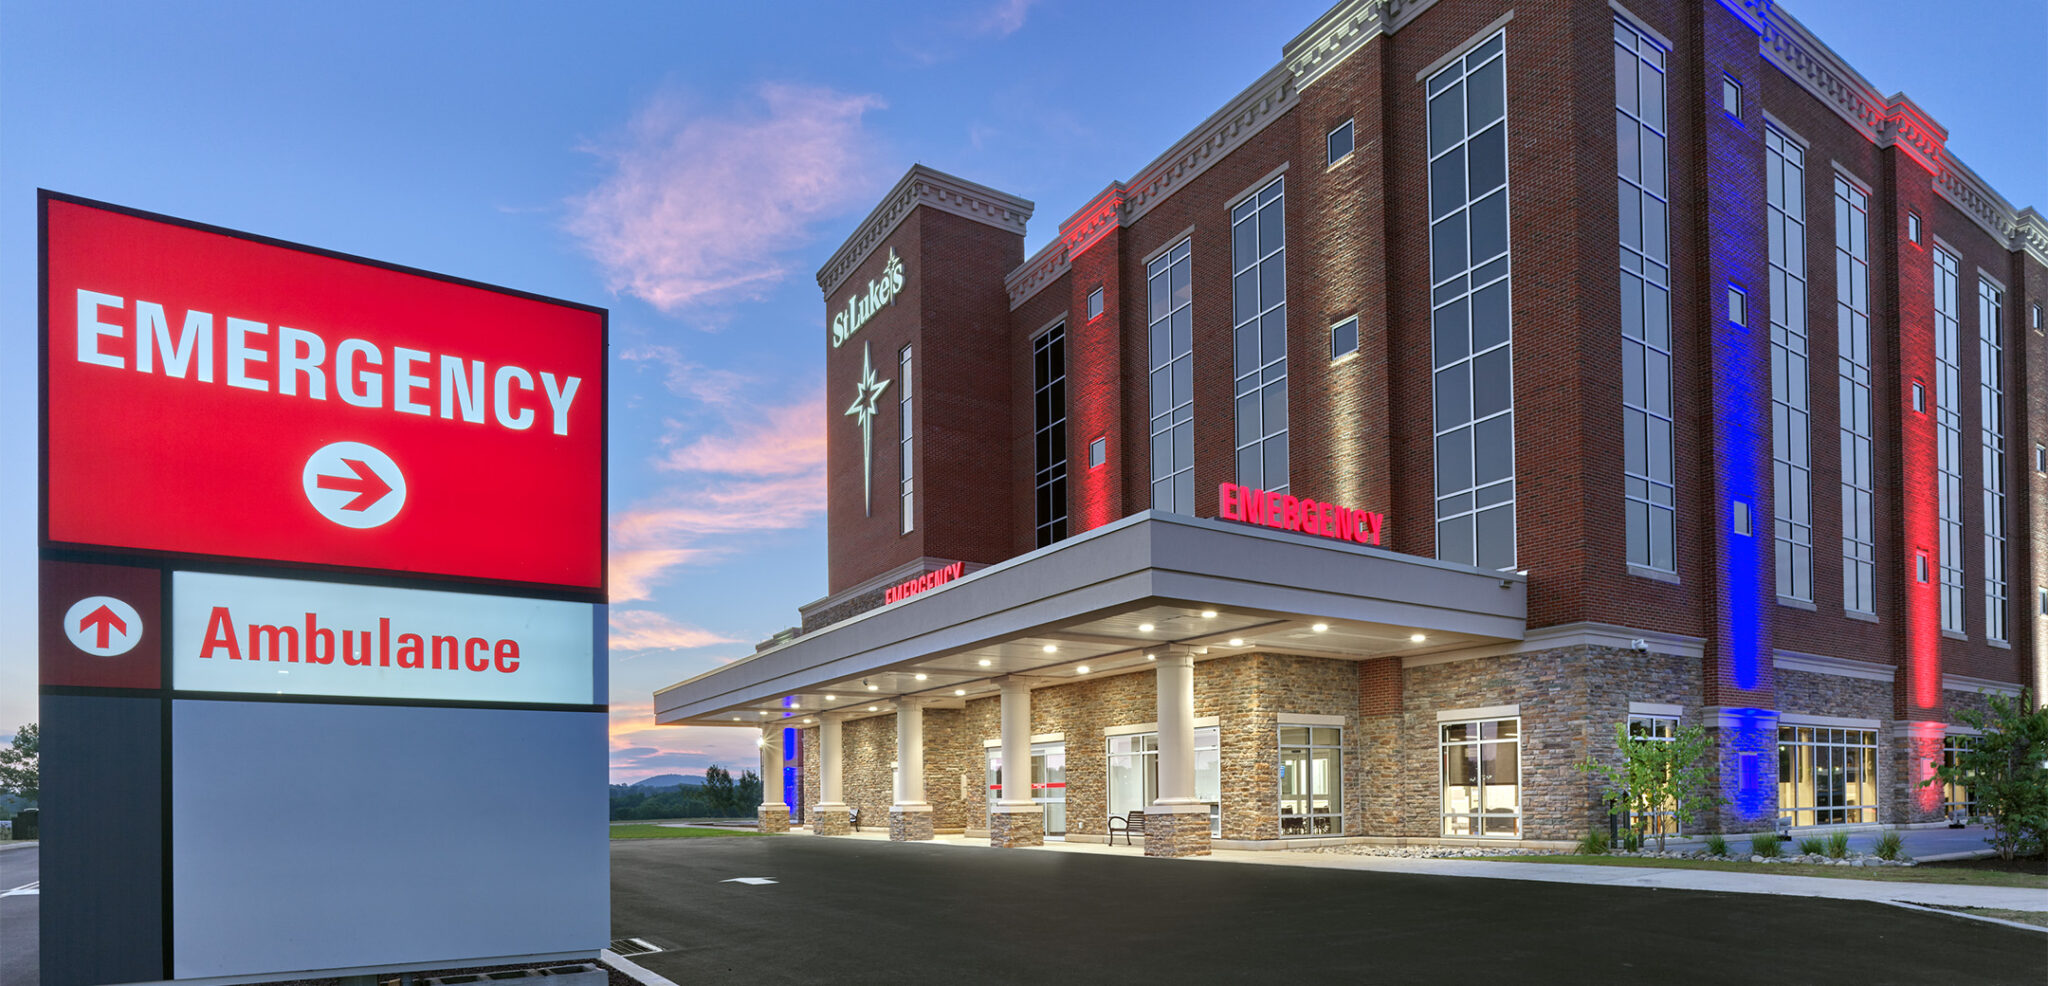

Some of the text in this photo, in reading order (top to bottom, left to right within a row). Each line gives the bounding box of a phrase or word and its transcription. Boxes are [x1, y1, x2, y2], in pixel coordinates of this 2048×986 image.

[77, 288, 582, 436] EMERGENCY
[1219, 482, 1384, 546] EMERGENCY
[885, 561, 965, 605] EMERGENCY
[200, 606, 521, 673] Ambulance
